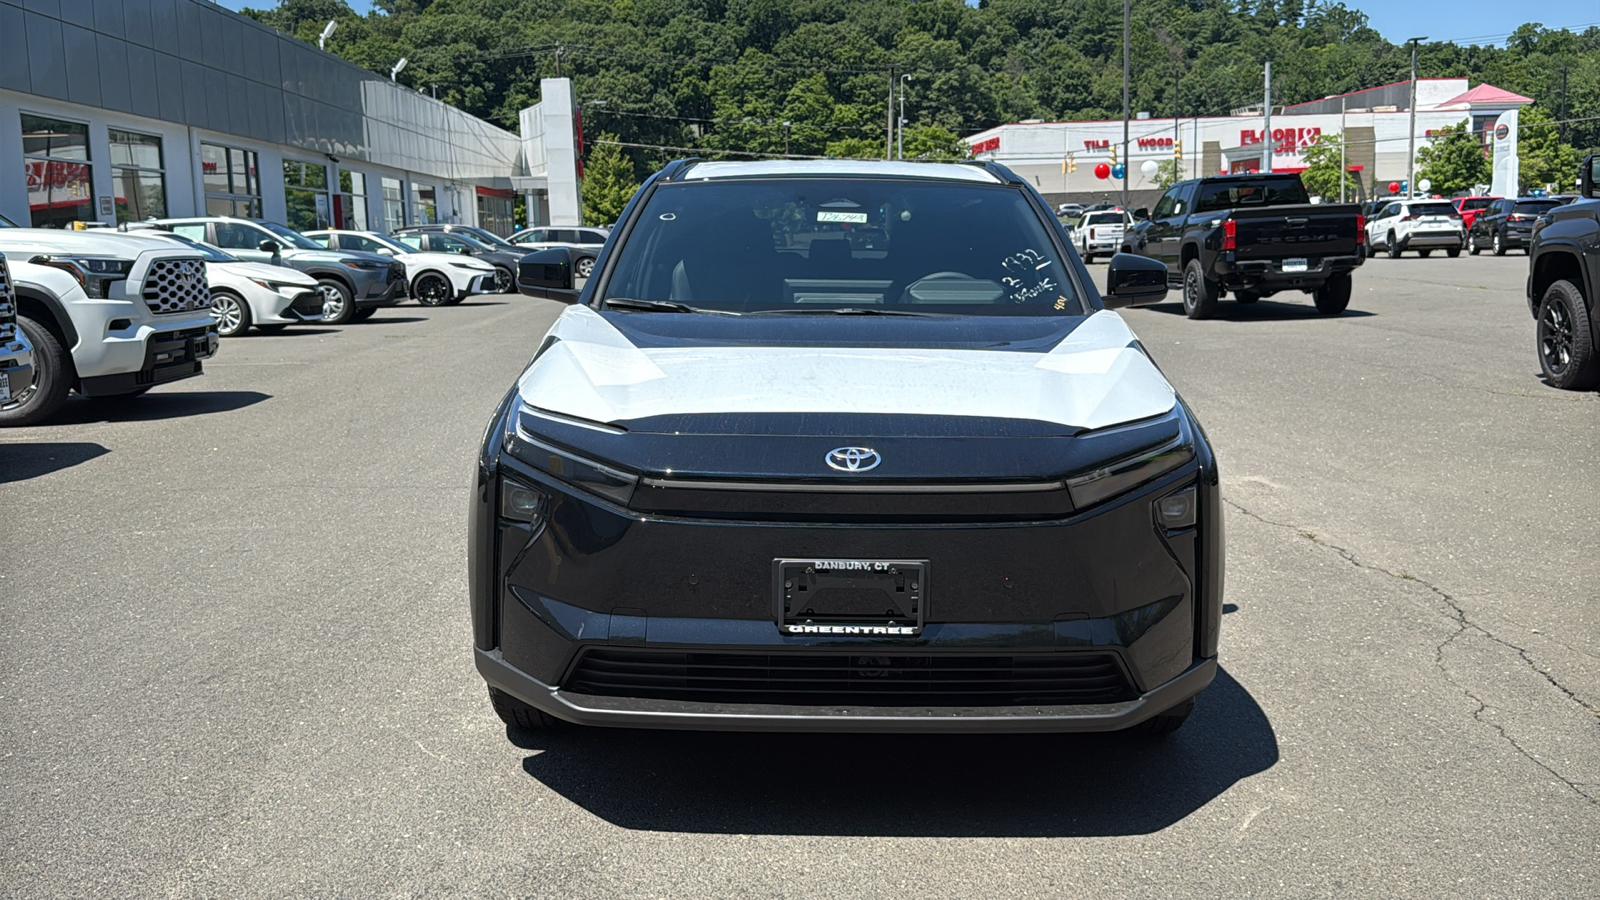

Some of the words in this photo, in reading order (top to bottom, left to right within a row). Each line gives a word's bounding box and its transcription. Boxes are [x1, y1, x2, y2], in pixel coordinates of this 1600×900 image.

[1083, 139, 1110, 150] TILE
[1137, 137, 1173, 148] WOOD
[815, 561, 871, 571] DANBURY,
[874, 562, 890, 570] CT
[789, 626, 914, 634] GREENTREE
